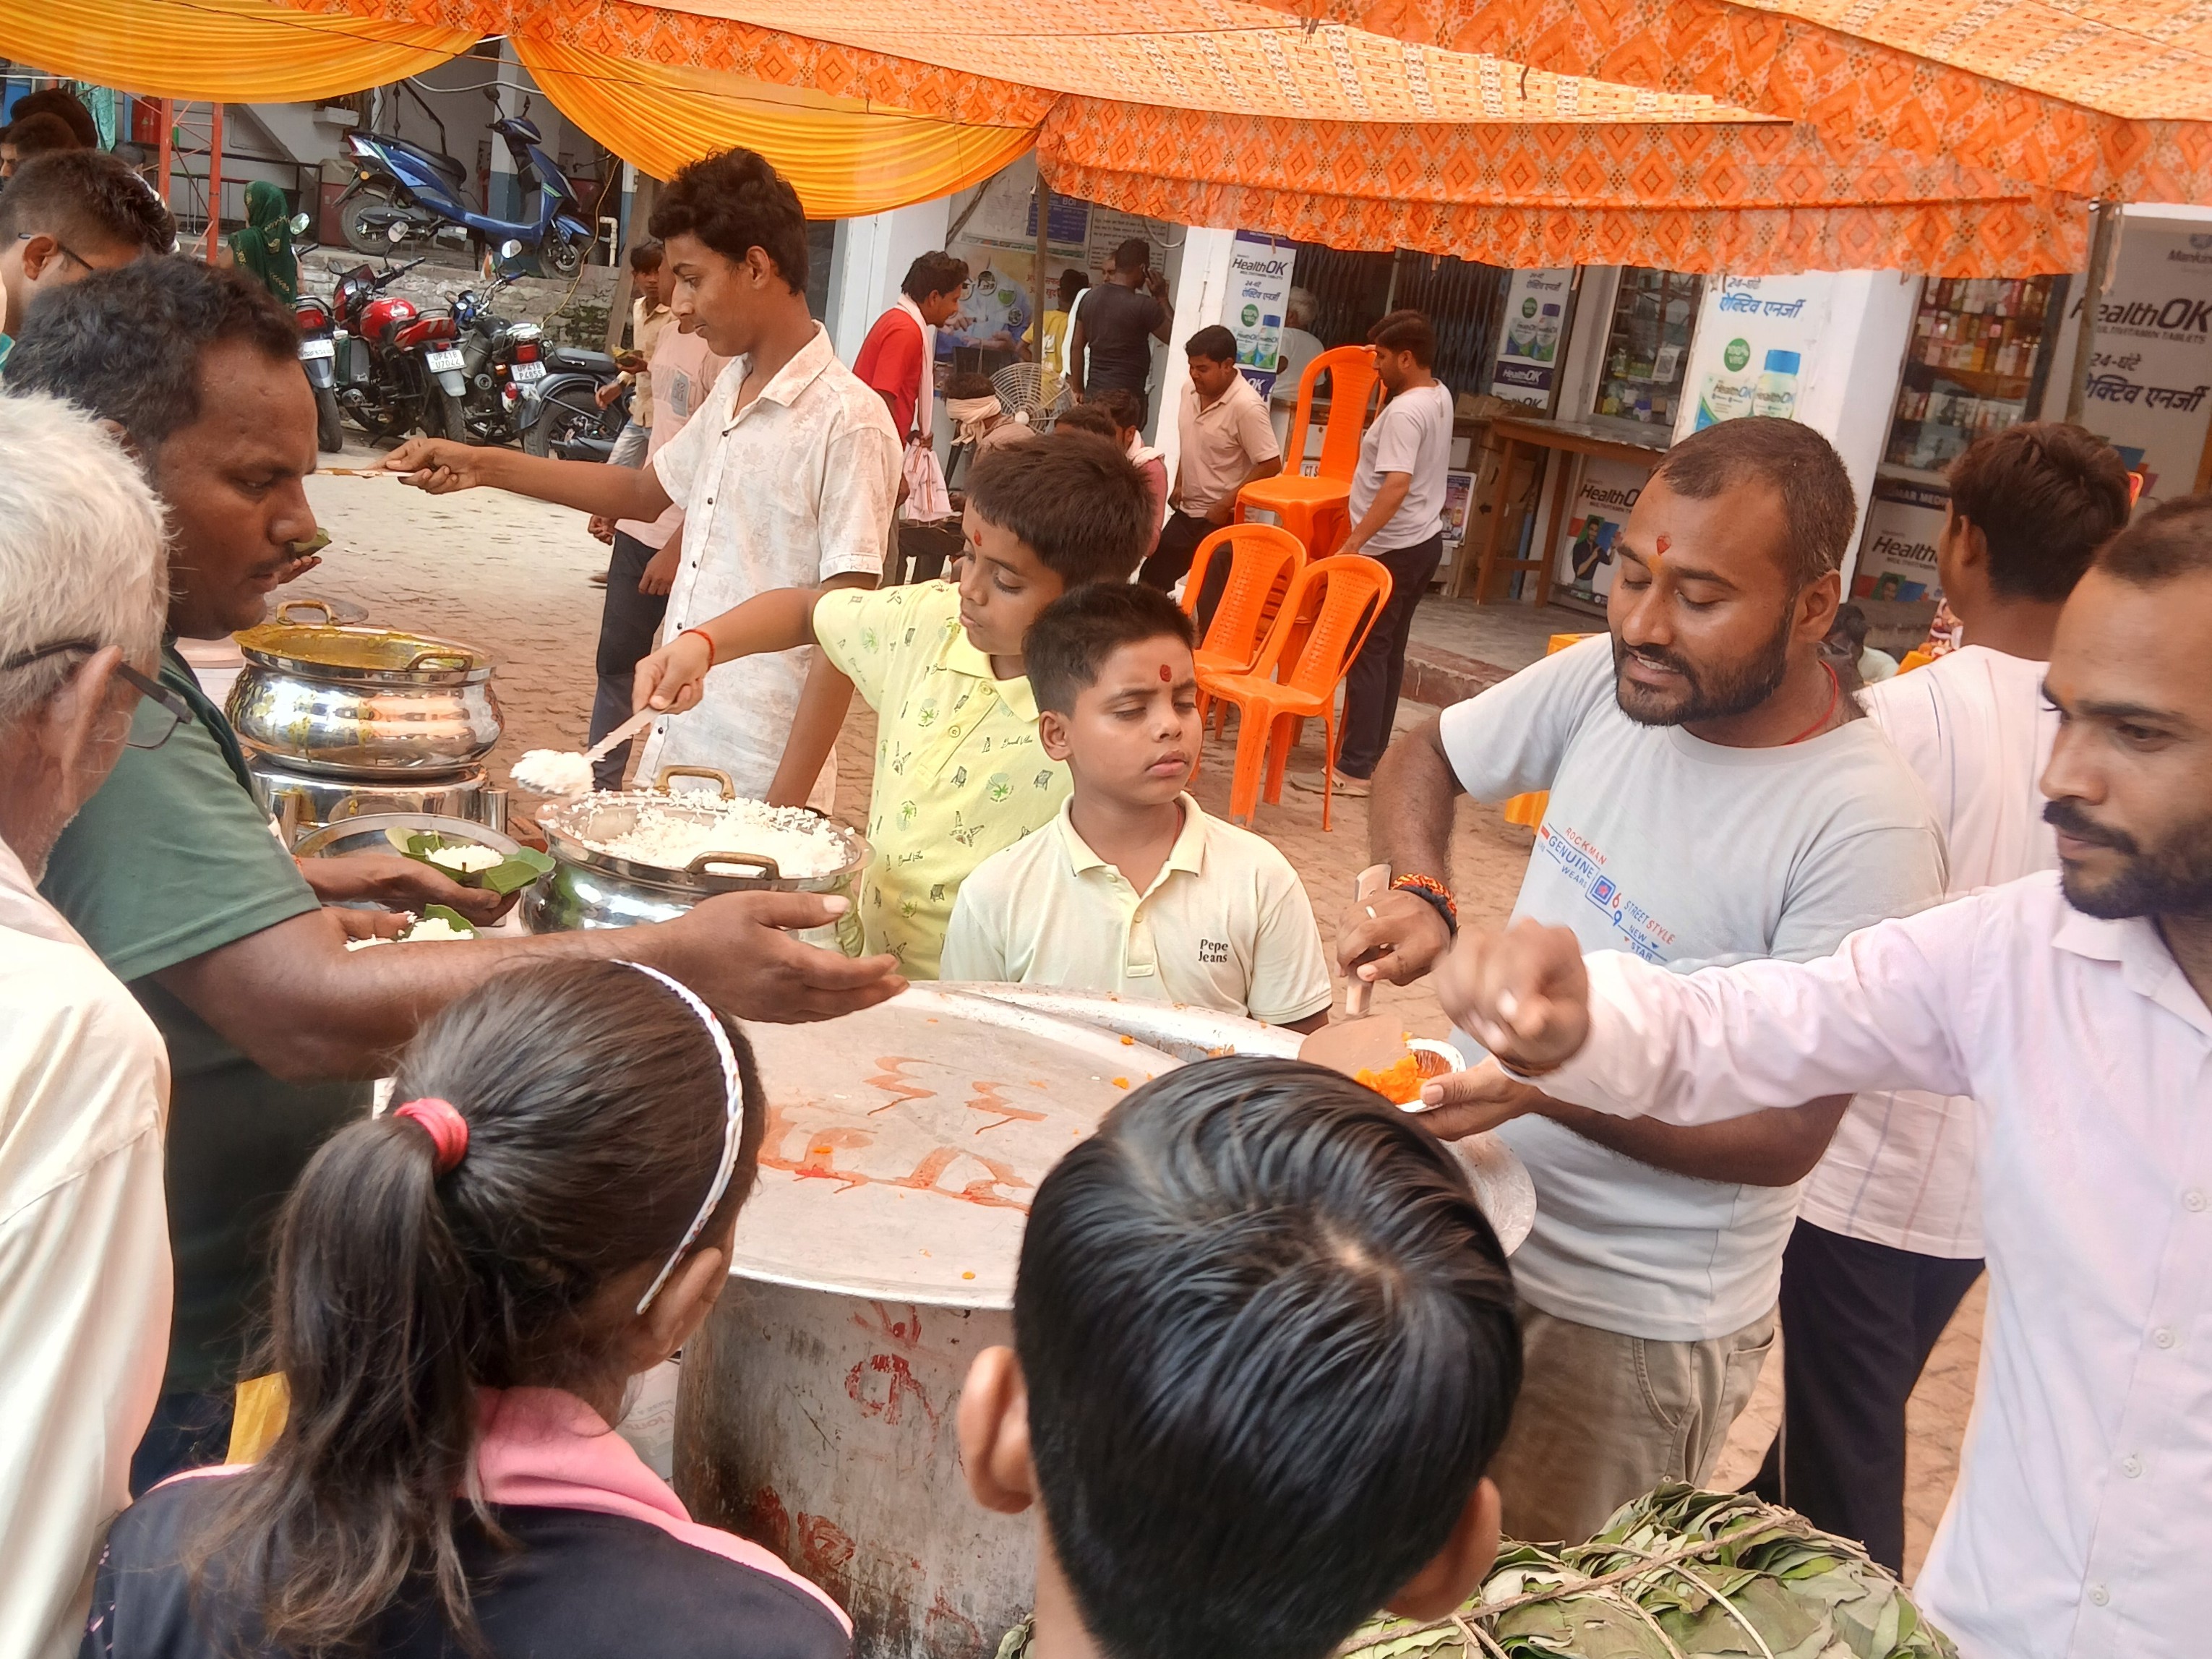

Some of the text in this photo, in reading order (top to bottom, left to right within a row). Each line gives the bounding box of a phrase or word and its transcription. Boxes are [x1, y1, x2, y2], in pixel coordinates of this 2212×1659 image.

[1231, 258, 1288, 276] HealthOK
[2145, 385, 2211, 413] एनर्जी
[1579, 484, 1639, 507] HealthO
[1872, 536, 1937, 563] Health
[1548, 836, 1595, 879] GENUINE
[1565, 827, 1607, 865] ROCKMAN
[1561, 865, 1588, 889] WEARS
[1624, 900, 1676, 945] STREET STYLE
[1629, 925, 1647, 943] NEW
[1198, 950, 1227, 963] Jeans
[1200, 938, 1229, 953] Pepe
[1630, 942, 1653, 961] STAR
